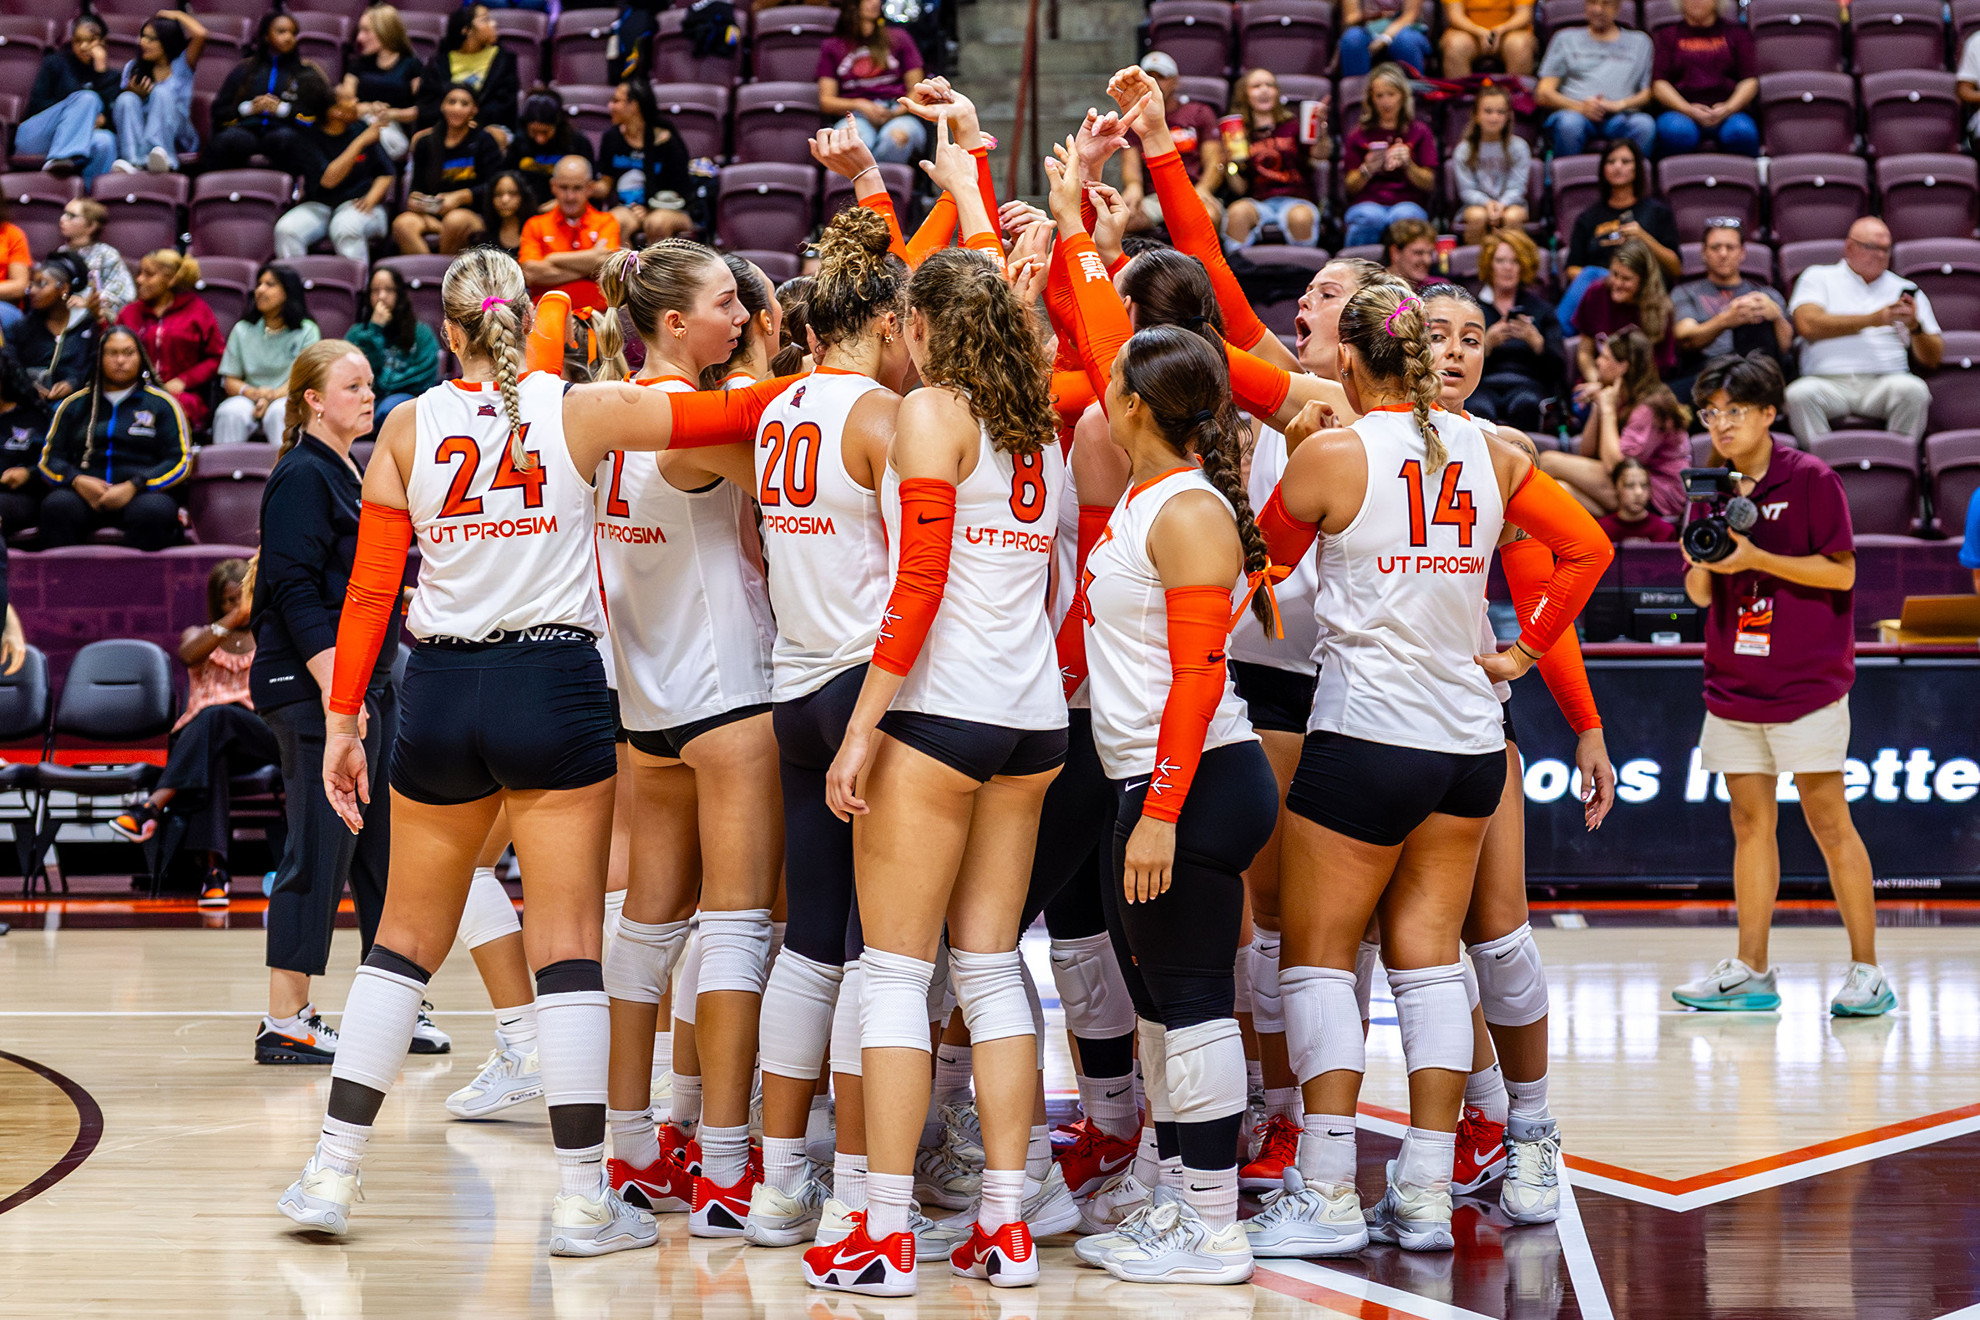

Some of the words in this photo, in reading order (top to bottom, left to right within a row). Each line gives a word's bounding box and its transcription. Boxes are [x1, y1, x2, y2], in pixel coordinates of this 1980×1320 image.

[434, 422, 547, 519] 24
[761, 420, 822, 508] 20
[1008, 451, 1048, 524] 8
[1398, 458, 1478, 548] 14
[1761, 501, 1789, 520] VT
[429, 525, 457, 544] UT
[463, 515, 558, 541] PROSIM
[608, 523, 667, 544] PROSIM
[768, 515, 836, 535] PROSIM
[965, 526, 998, 546] UT
[1377, 556, 1411, 574] UT
[1416, 556, 1485, 574] PROSIM
[517, 627, 586, 643] NIKE
